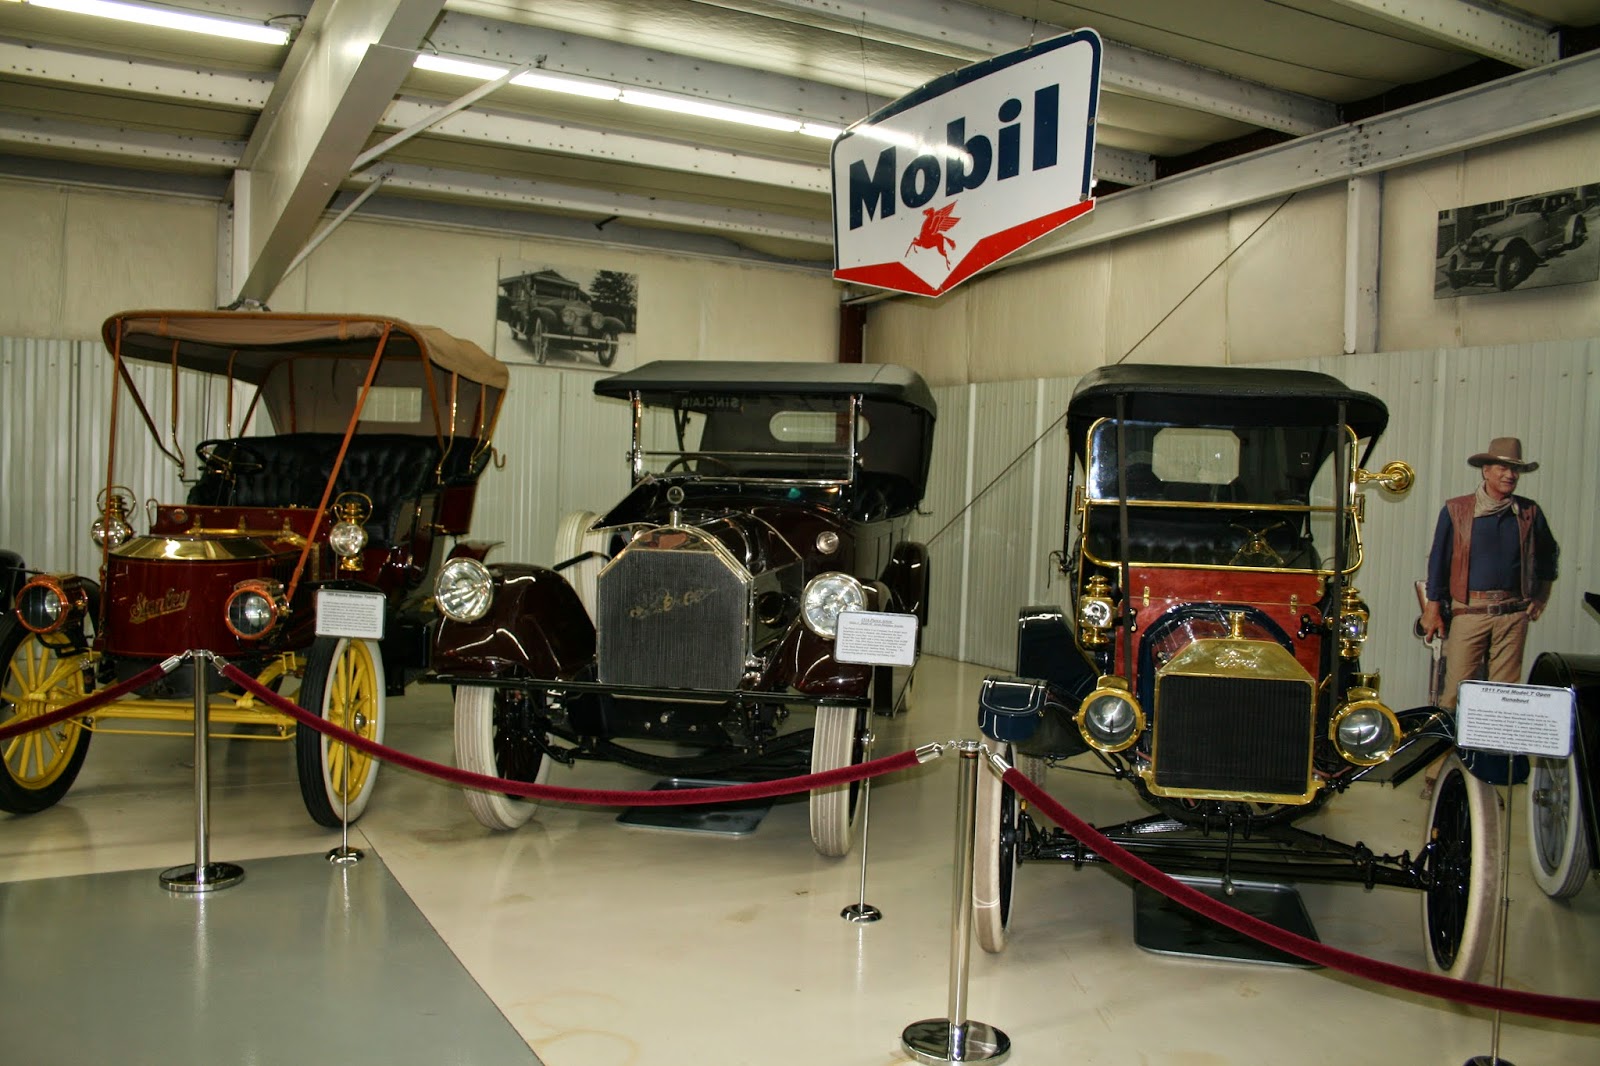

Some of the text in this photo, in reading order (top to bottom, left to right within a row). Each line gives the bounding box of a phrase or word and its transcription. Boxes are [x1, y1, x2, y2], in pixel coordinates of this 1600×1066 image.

[849, 83, 1060, 231] Mobil
[129, 587, 191, 624] Stanley
[1214, 648, 1258, 669] Ford
